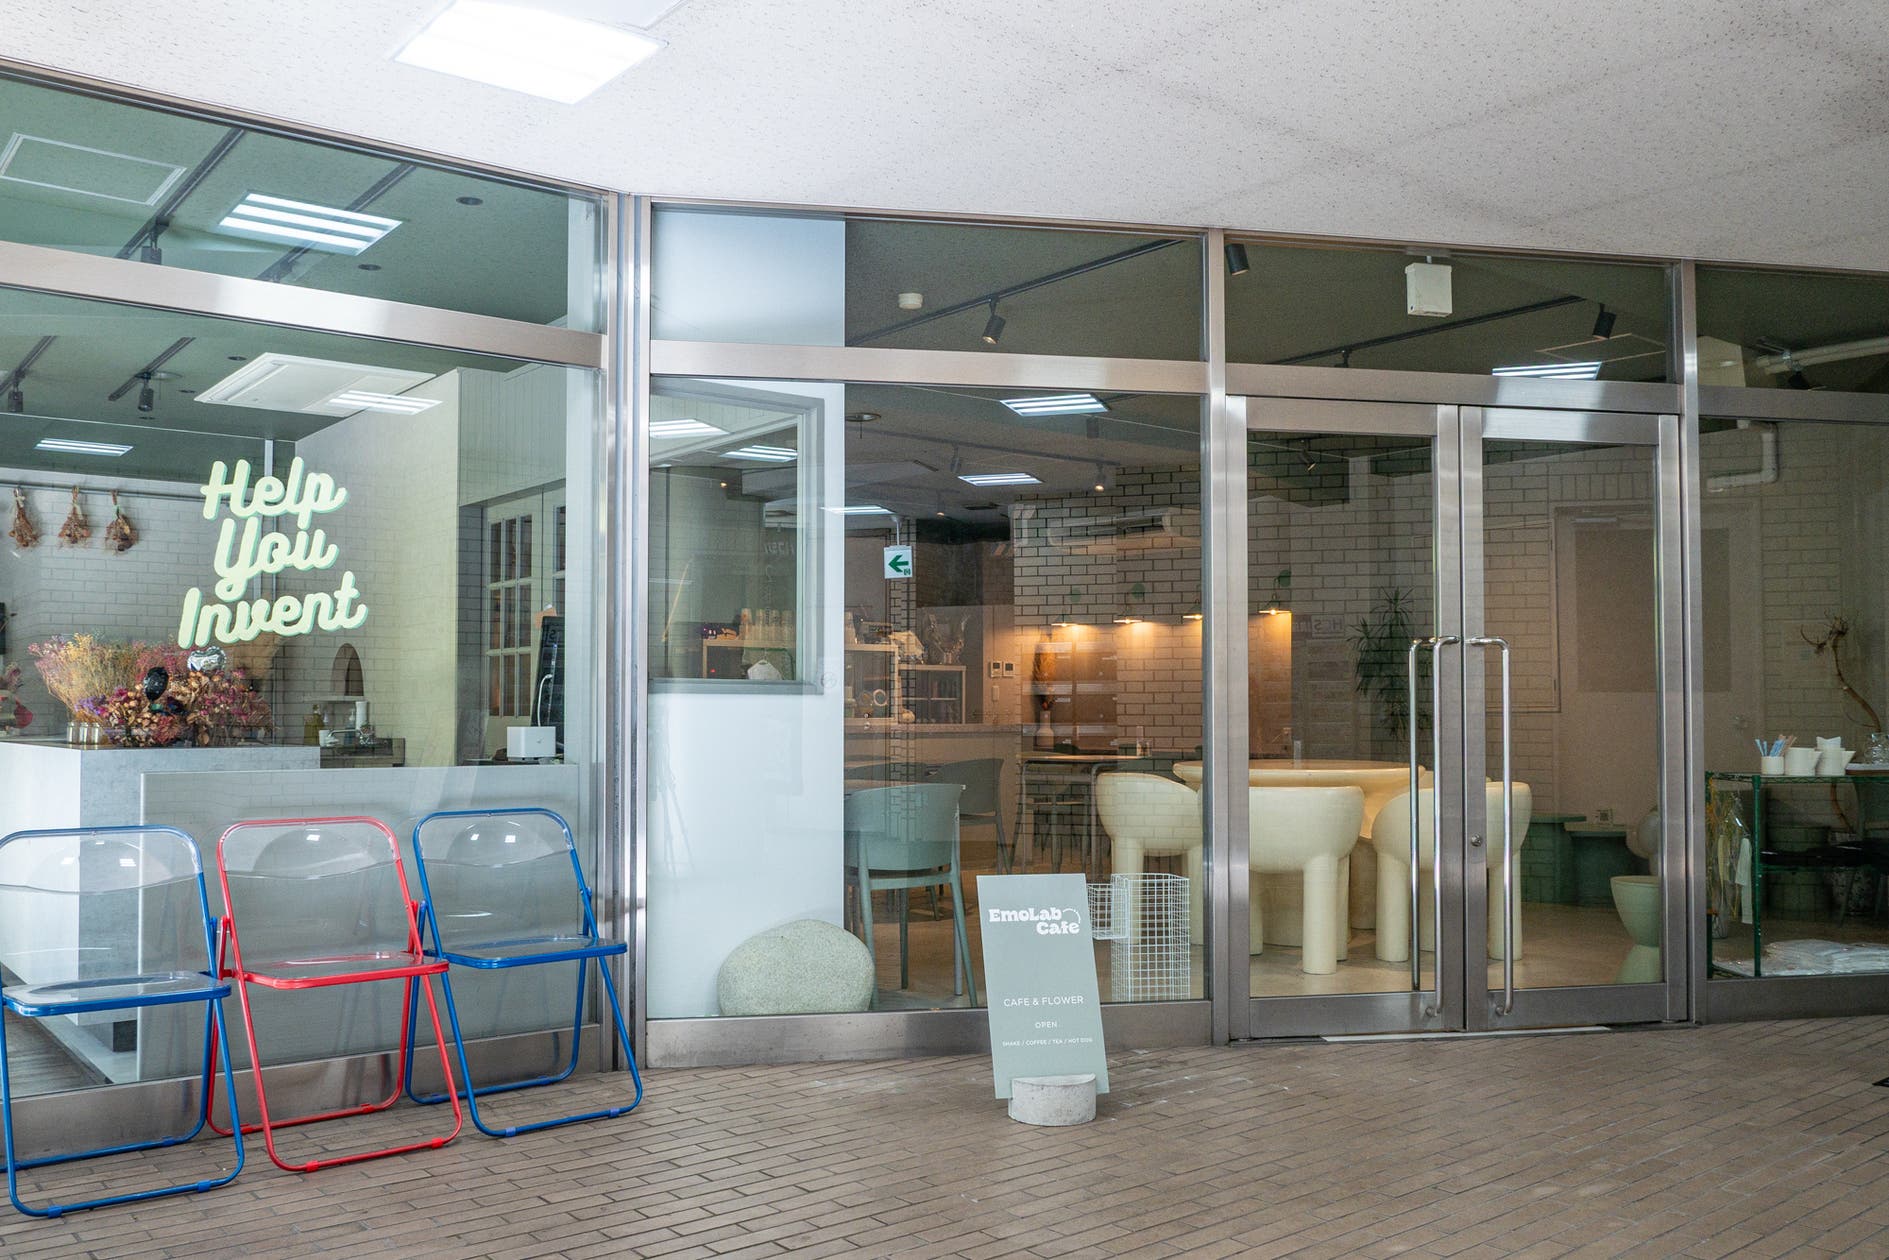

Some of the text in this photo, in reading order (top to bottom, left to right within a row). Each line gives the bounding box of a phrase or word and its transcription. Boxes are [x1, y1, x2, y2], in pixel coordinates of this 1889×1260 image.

[200, 456, 348, 530] Help
[214, 516, 340, 602] You
[178, 571, 369, 650] Invent
[988, 907, 1062, 922] EmoLab
[1036, 920, 1080, 935] Cafe
[1003, 995, 1084, 1007] CAFE & FLOWER
[1035, 1021, 1058, 1029] OPEN
